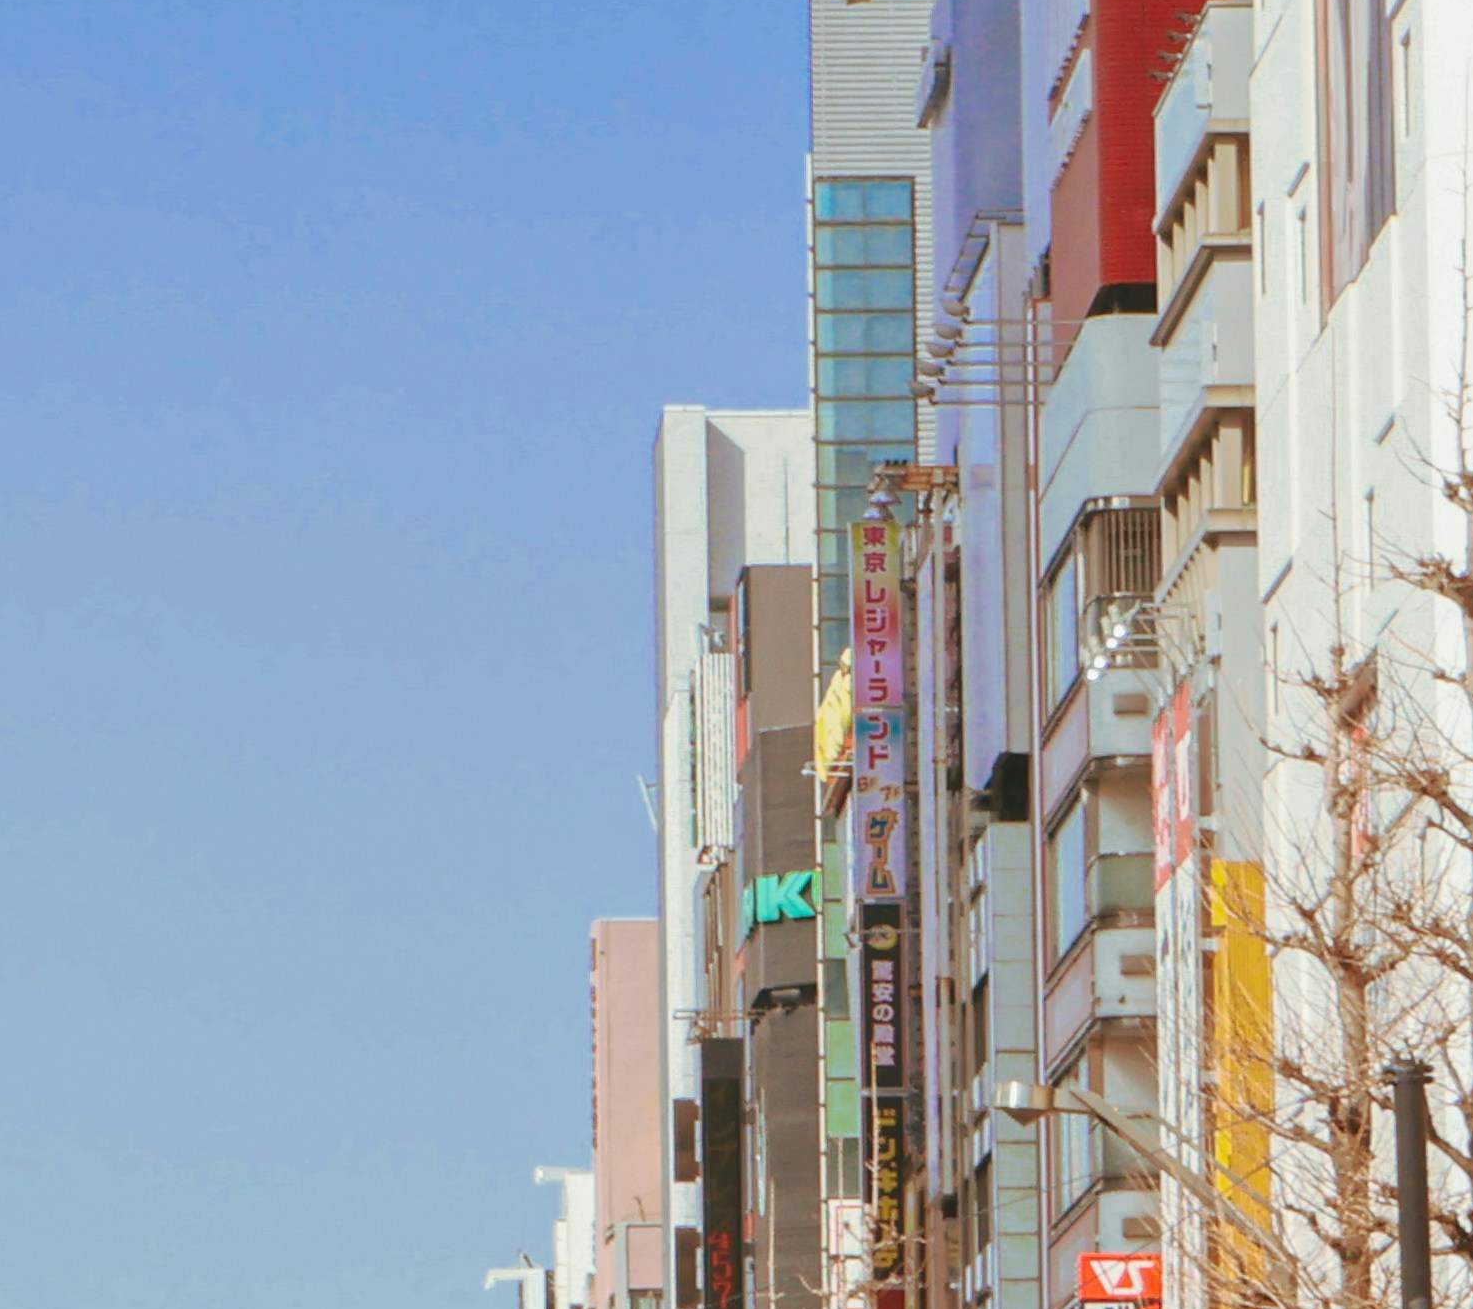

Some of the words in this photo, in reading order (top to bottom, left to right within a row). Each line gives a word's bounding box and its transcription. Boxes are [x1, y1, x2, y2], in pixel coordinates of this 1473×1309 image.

[863, 526, 890, 771] 東京レジャーランド
